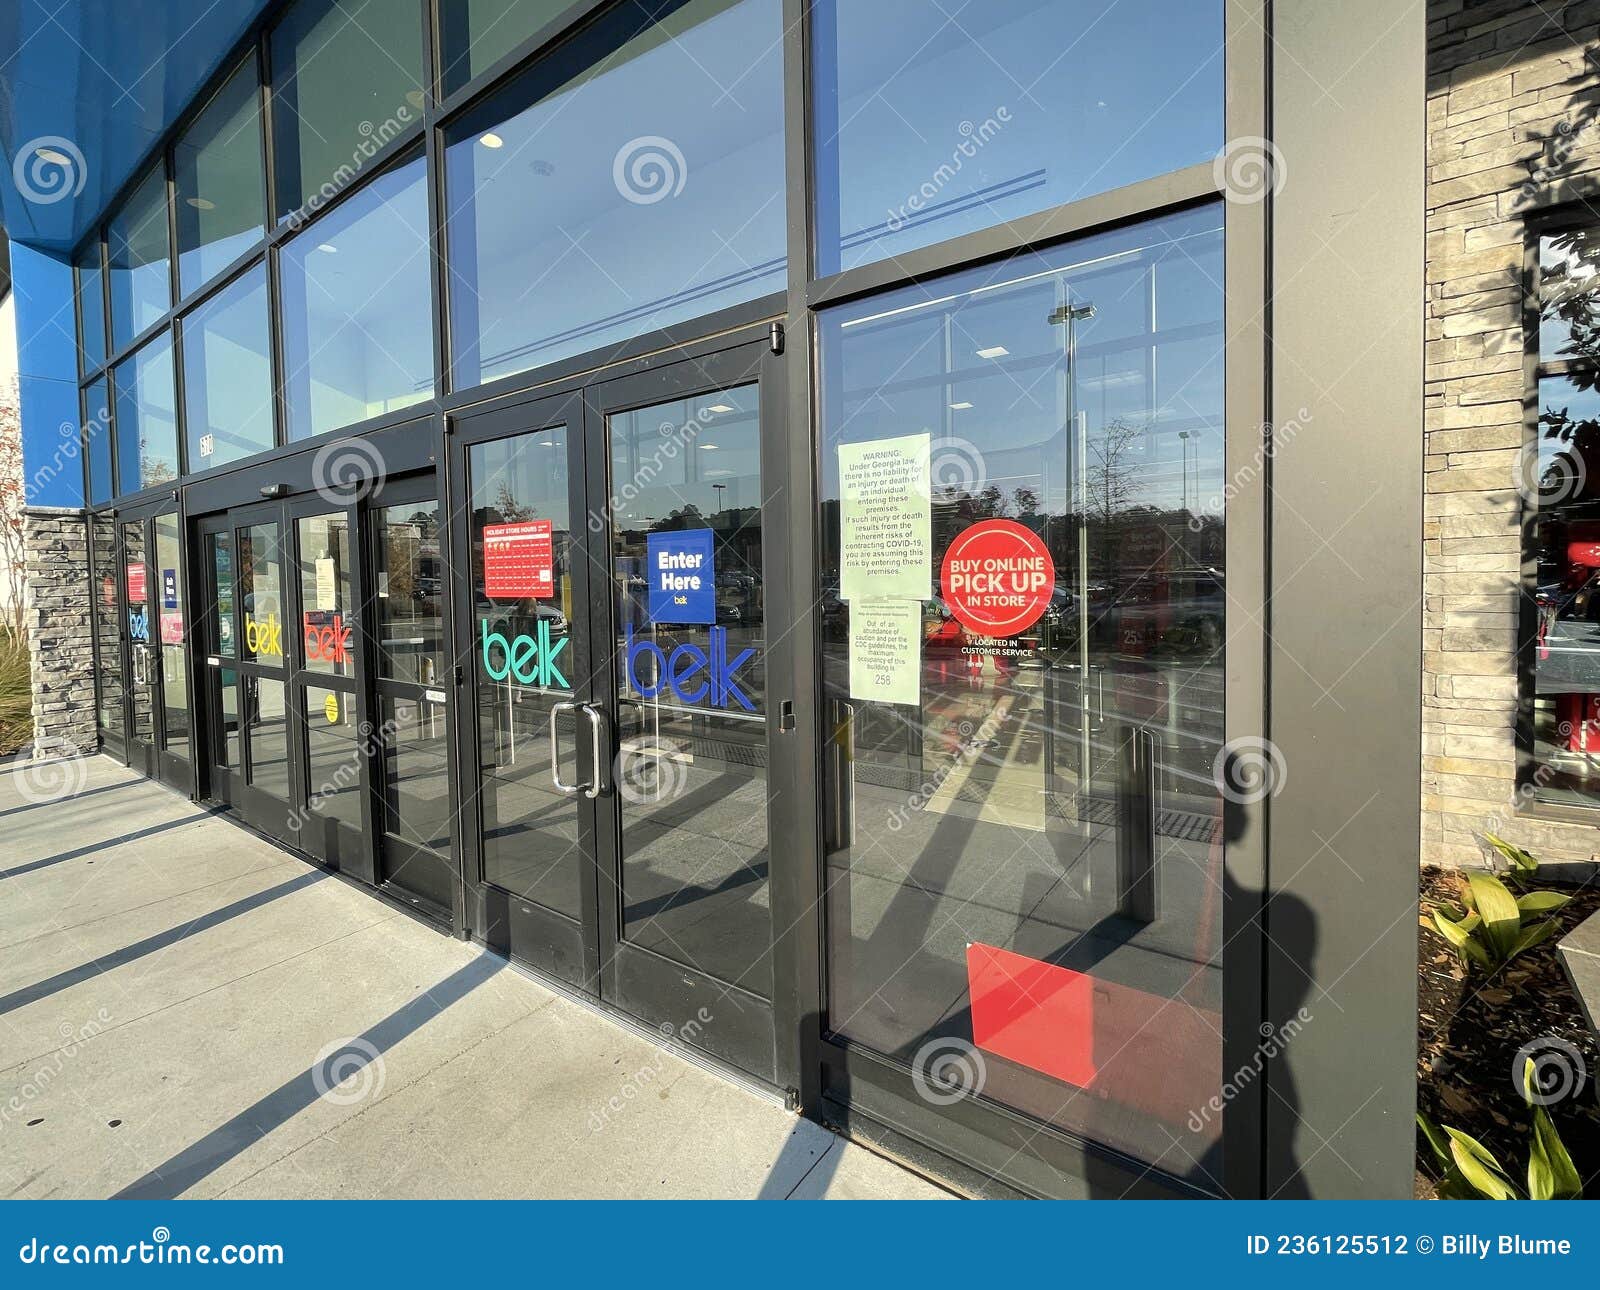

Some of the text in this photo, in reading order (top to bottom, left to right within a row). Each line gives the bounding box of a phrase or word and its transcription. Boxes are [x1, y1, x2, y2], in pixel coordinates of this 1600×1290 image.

[849, 463, 870, 471] Under
[872, 460, 901, 469] Georgia
[845, 471, 863, 480] there
[883, 467, 910, 477] liability
[911, 466, 922, 474] for
[858, 480, 878, 489] injury
[889, 476, 910, 484] death
[871, 486, 906, 496] individual
[857, 497, 887, 505] entering
[851, 515, 869, 523] such
[871, 514, 891, 523] injury
[902, 512, 923, 520] death
[856, 524, 880, 532] results
[855, 530, 913, 541] inherent risks of
[845, 542, 885, 550] contracting
[658, 552, 703, 569] Enter
[845, 552, 859, 560] you
[872, 550, 908, 558] assuming
[861, 560, 870, 568] by
[871, 559, 901, 567] entering
[902, 558, 923, 566] these
[950, 557, 1045, 573] BUY ONLINE
[661, 572, 701, 591] Here
[950, 572, 1047, 593] PICK UP
[967, 595, 1026, 607] IN STORE
[246, 612, 283, 656] belk
[304, 611, 352, 664] belk
[974, 639, 1018, 647] LOCATED IN
[482, 618, 571, 688] belk
[961, 647, 1033, 657] CUSTOMER SERVICE
[626, 622, 757, 711] belk
[875, 674, 891, 686] 258
